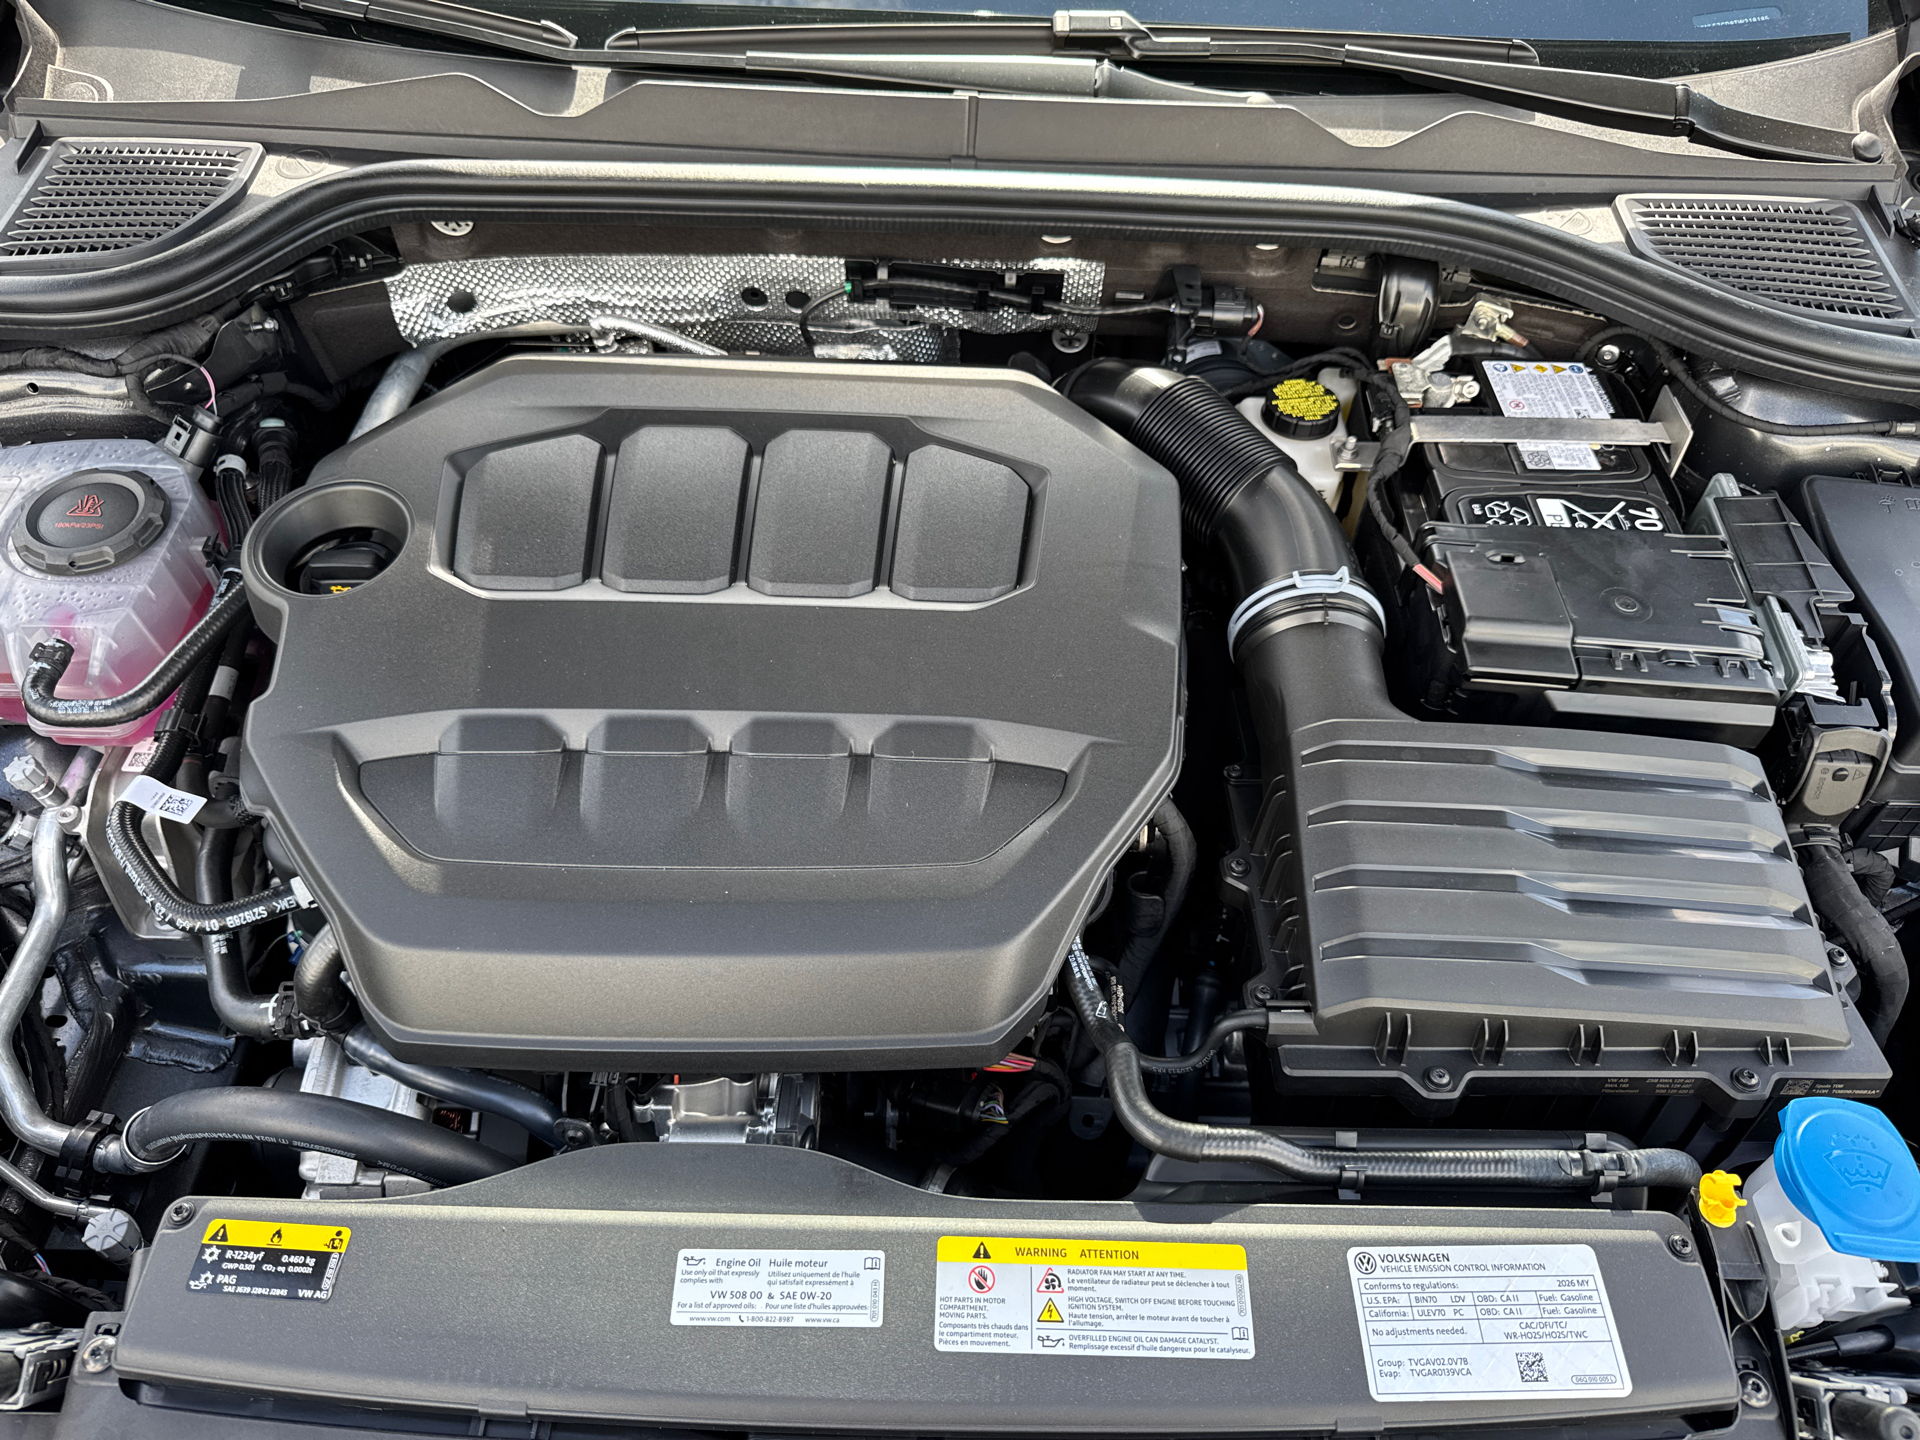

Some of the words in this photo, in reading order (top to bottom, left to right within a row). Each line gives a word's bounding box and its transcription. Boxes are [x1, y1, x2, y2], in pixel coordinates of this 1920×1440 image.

[226, 906, 268, 928] S21928B
[225, 1249, 265, 1263] R-1234yf
[1015, 1247, 1066, 1257] WARNING
[1080, 1249, 1138, 1259] ATTENTION
[1378, 1253, 1450, 1263] VOLKSWAGEN
[281, 1254, 304, 1263] 0.460
[305, 1256, 316, 1266] kg
[716, 1258, 746, 1269] Engine
[748, 1258, 761, 1266] Oil
[769, 1258, 792, 1267] Huile
[794, 1259, 828, 1267] moteur
[1414, 1264, 1452, 1272] EMISSION
[1453, 1263, 1490, 1271] CONTROL
[1491, 1263, 1546, 1271] INFORMATION
[693, 1269, 707, 1278] only
[731, 1269, 760, 1278] expressly
[216, 1274, 237, 1284] PAG
[1556, 1279, 1575, 1287] 2026
[1363, 1281, 1401, 1290] Conforms
[1412, 1281, 1458, 1290] regulations:
[298, 1289, 314, 1298] VW
[313, 1290, 327, 1299] AG
[710, 1290, 727, 1298] VW
[730, 1290, 747, 1299] 508
[749, 1290, 762, 1299] 00
[780, 1291, 797, 1300] SAE
[1366, 1296, 1381, 1304] U.S.
[1382, 1296, 1400, 1304] EPA:
[1414, 1295, 1437, 1303] BIN70
[1450, 1295, 1465, 1303] LDV
[1476, 1294, 1497, 1302] OBD:
[1500, 1294, 1512, 1302] CA
[1538, 1293, 1557, 1301] Fuel:
[1560, 1293, 1593, 1301] Gasoline
[1084, 1296, 1113, 1304] VOLTAGE,
[712, 1302, 742, 1310] approved
[939, 1303, 988, 1311] COMPARTMENT.
[1368, 1309, 1409, 1317] California:
[1417, 1308, 1446, 1317] ULEV70
[1453, 1308, 1464, 1316] PC
[1479, 1308, 1500, 1316] OBD:
[1503, 1307, 1515, 1315] CA
[1542, 1306, 1561, 1314] Fuel:
[1563, 1306, 1597, 1314] Gasoline
[938, 1321, 977, 1329] Composants
[1372, 1328, 1383, 1336] No
[1385, 1327, 1434, 1337] adjustments
[1436, 1326, 1467, 1335] needed.
[1069, 1342, 1109, 1351] Remplissage
[1158, 1345, 1192, 1353] dangereux
[1216, 1346, 1250, 1355] catalyseur.
[1377, 1358, 1405, 1368] Group:
[1379, 1369, 1400, 1379] Evap:
